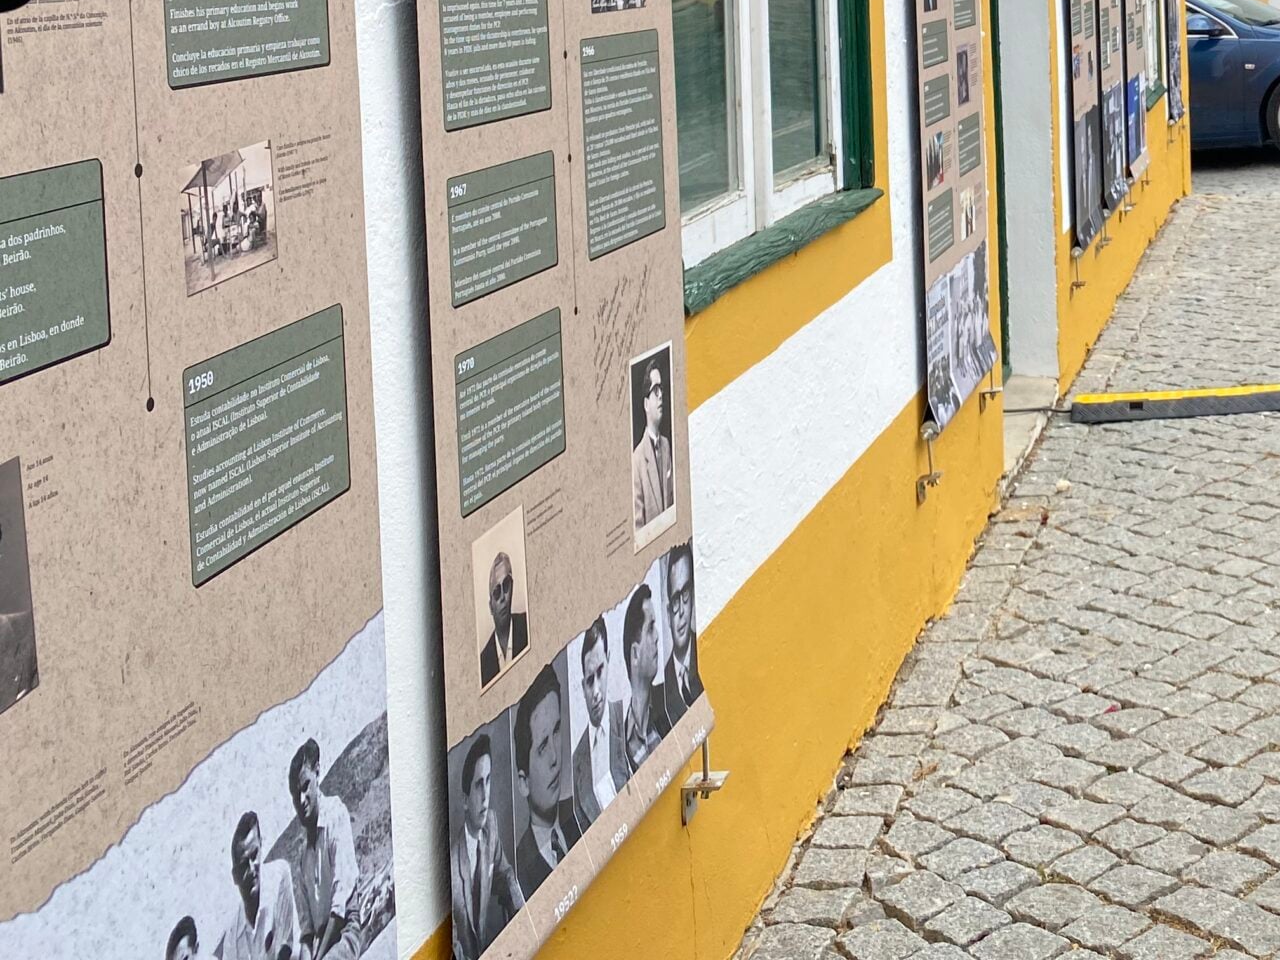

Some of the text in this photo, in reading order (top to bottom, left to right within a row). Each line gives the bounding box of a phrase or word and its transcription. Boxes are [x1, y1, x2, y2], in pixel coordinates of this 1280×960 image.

[170, 0, 298, 18] Finishes his primary education and begins work
[171, 25, 177, 33] as
[187, 20, 208, 31] errand
[209, 19, 219, 31] boy
[220, 19, 227, 28] at
[227, 16, 251, 27] Alcoutim
[252, 14, 273, 27] Registry
[273, 13, 290, 23] Office.
[172, 50, 199, 65] Concluye
[200, 49, 206, 59] la
[207, 46, 235, 58] educación
[236, 43, 260, 57] primaria
[261, 45, 264, 53] y
[265, 40, 286, 53] empieza
[173, 66, 188, 77] chico
[190, 64, 197, 75] de
[198, 63, 207, 74] los
[208, 60, 229, 72] recados
[239, 58, 244, 68] el
[245, 56, 266, 69] Registro
[267, 52, 290, 64] Mercantil
[291, 51, 298, 61] de
[450, 183, 467, 199] 1967
[8, 222, 65, 247] dos padrinhos,
[3, 247, 31, 265] Beirão.
[7, 315, 84, 350] en Lisboa, en donde
[457, 357, 475, 375] 1970
[188, 368, 213, 394] 1950
[190, 408, 210, 427] Estuda
[211, 390, 249, 416] contabilidade
[250, 388, 257, 398] no
[258, 376, 279, 394] Instituto
[280, 364, 304, 383] Comercial
[305, 360, 312, 371] de
[191, 433, 194, 441] o
[212, 414, 229, 431] ISCAL
[230, 401, 255, 422] (Instituto
[256, 390, 278, 411] Superior
[279, 386, 286, 398] de
[286, 370, 319, 394] Contabilidade
[191, 448, 195, 456] e
[196, 424, 237, 456] Administração
[239, 420, 245, 432] de
[610, 823, 629, 853] 1959
[554, 885, 579, 923] 1952?
